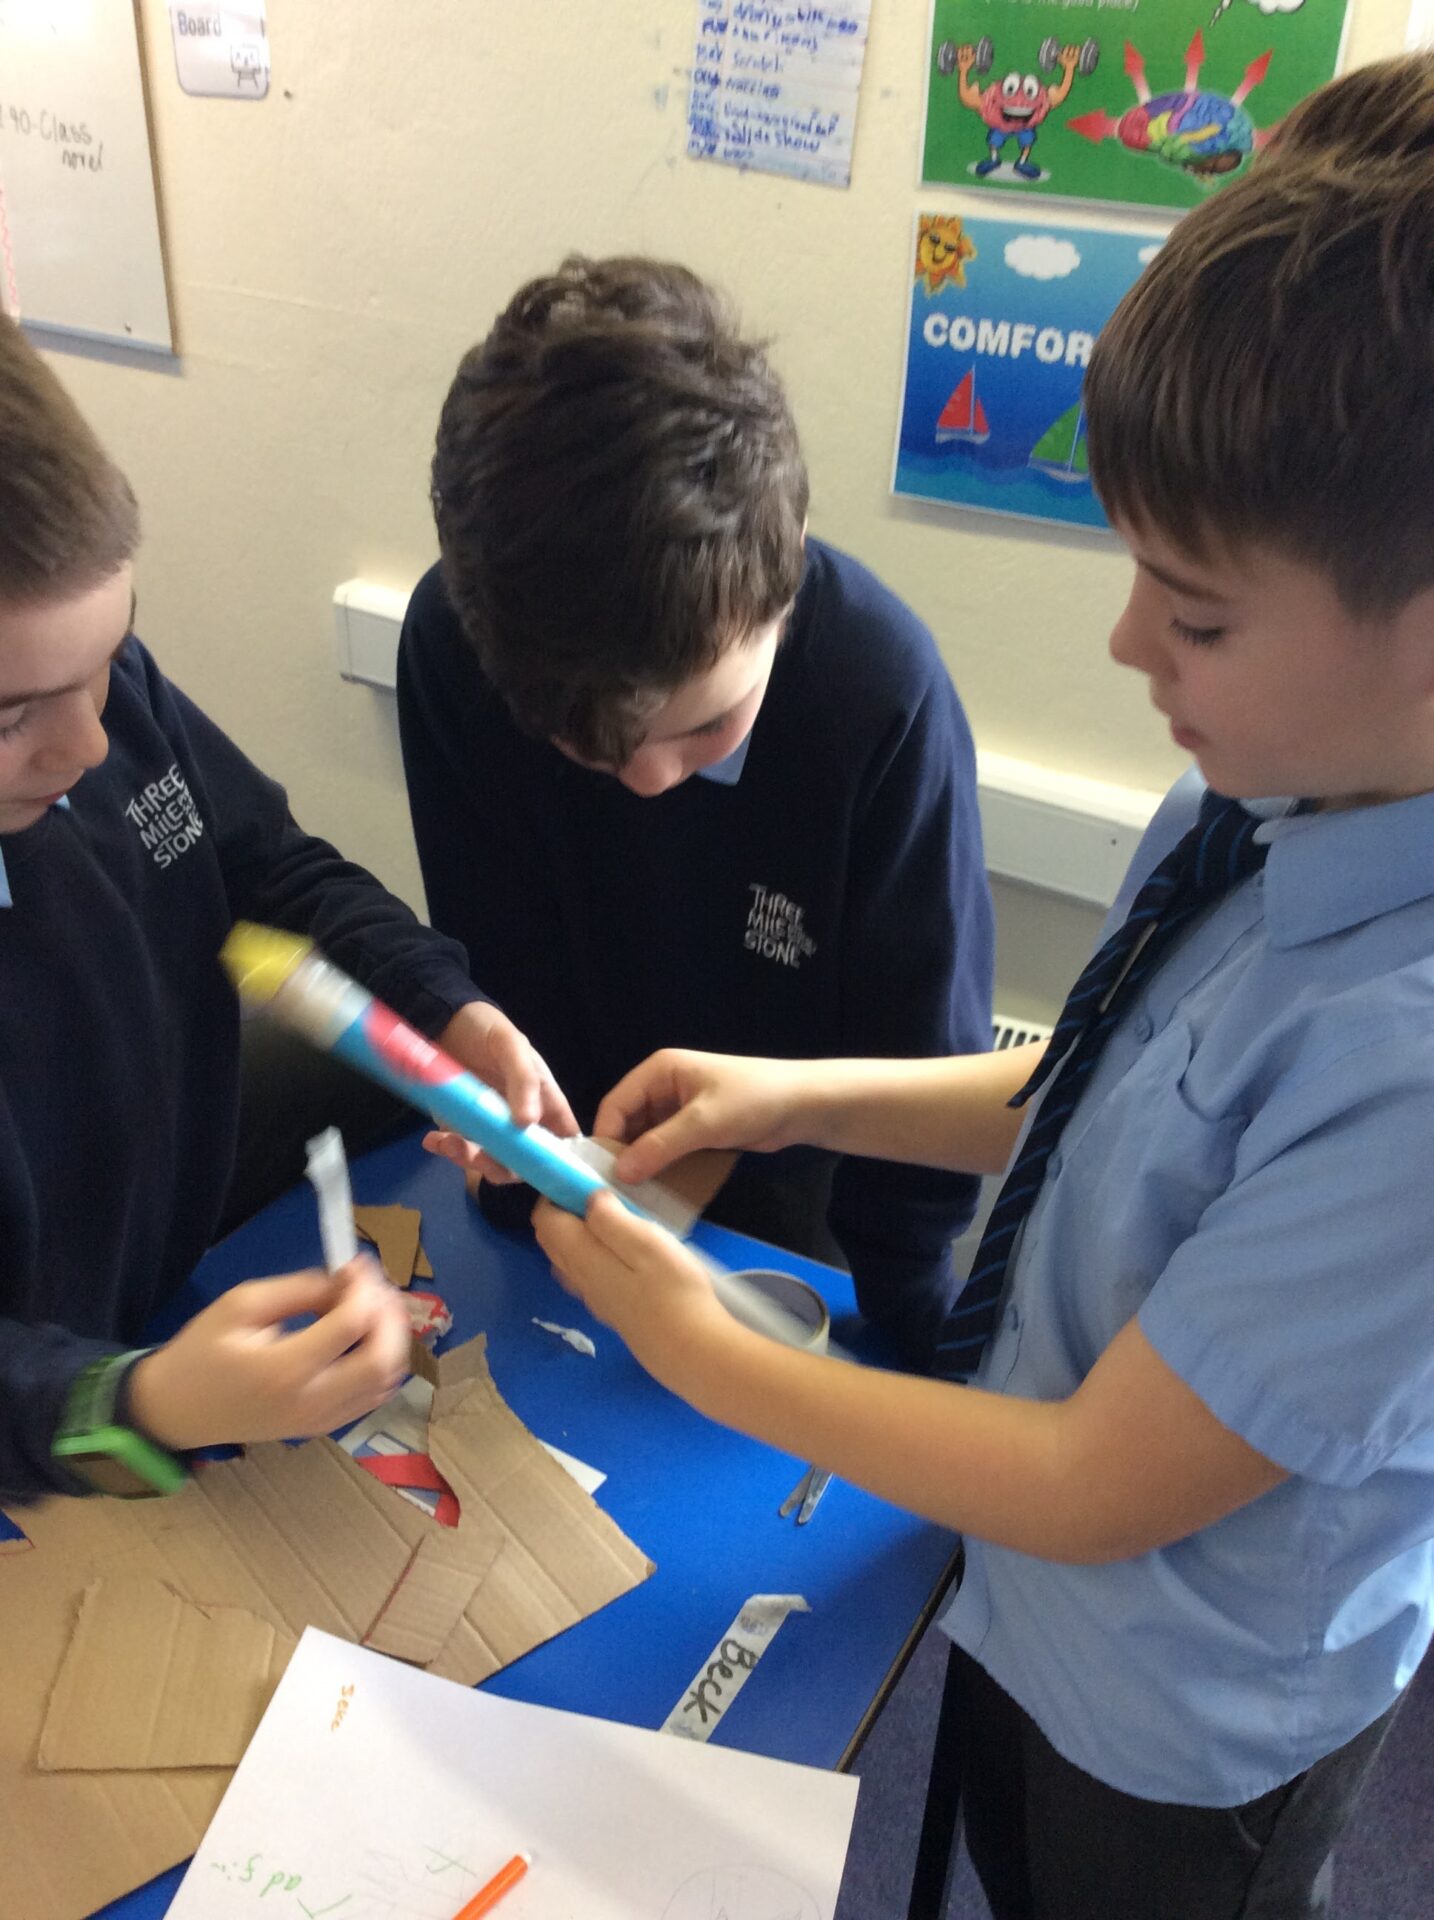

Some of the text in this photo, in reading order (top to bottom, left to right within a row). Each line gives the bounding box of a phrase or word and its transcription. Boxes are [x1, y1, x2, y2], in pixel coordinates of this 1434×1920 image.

[177, 10, 222, 37] Board
[125, 763, 186, 828] THREE
[153, 806, 204, 870] STONE
[749, 883, 805, 926] THREE
[683, 1639, 759, 1723] Beck
